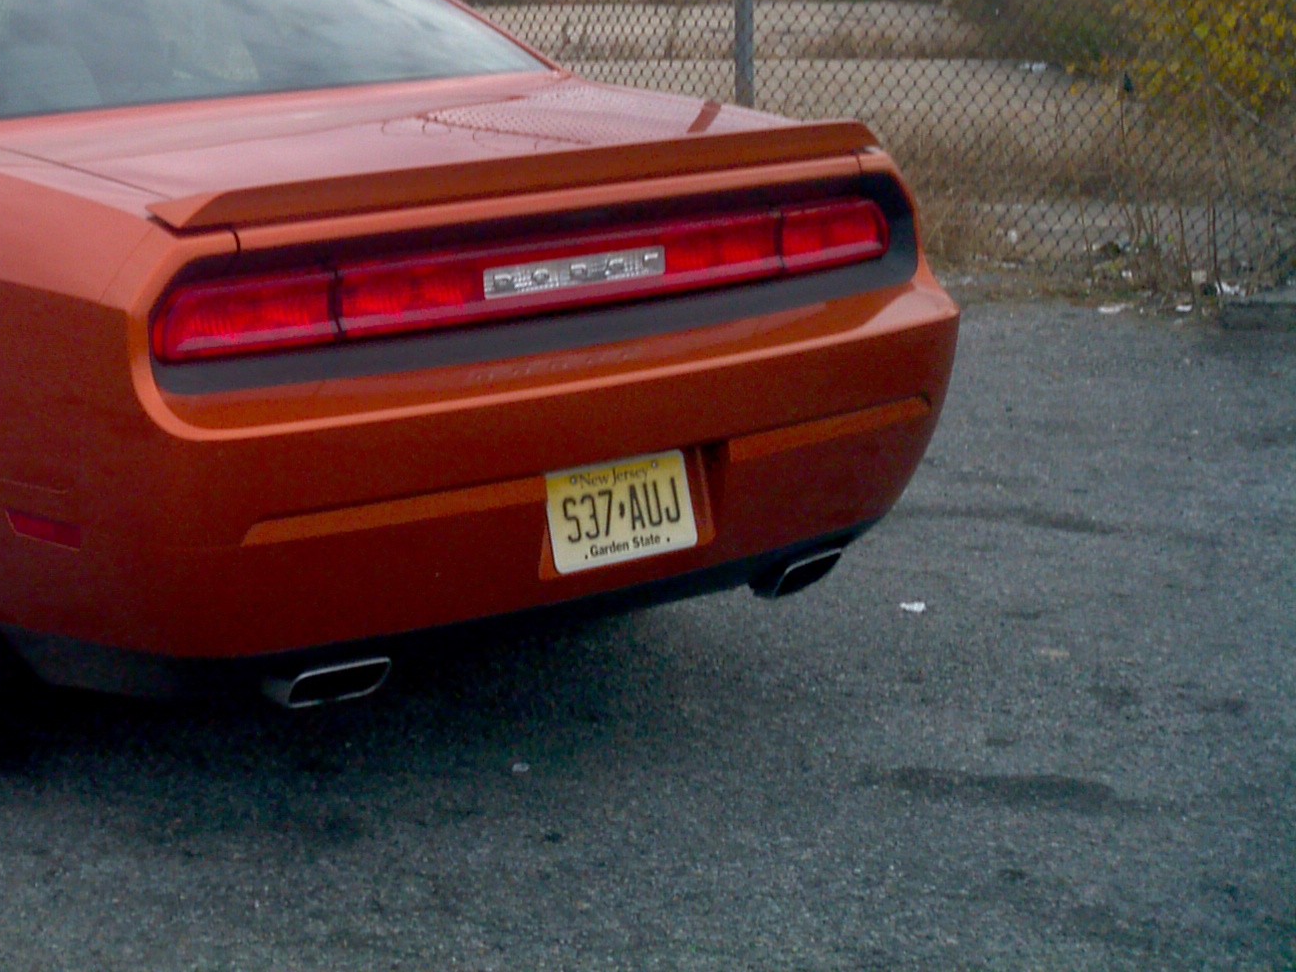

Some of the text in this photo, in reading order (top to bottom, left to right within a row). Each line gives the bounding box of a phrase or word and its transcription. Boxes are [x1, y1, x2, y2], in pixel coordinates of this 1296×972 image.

[580, 465, 649, 489] New Jersey
[590, 535, 661, 557] Garden State
